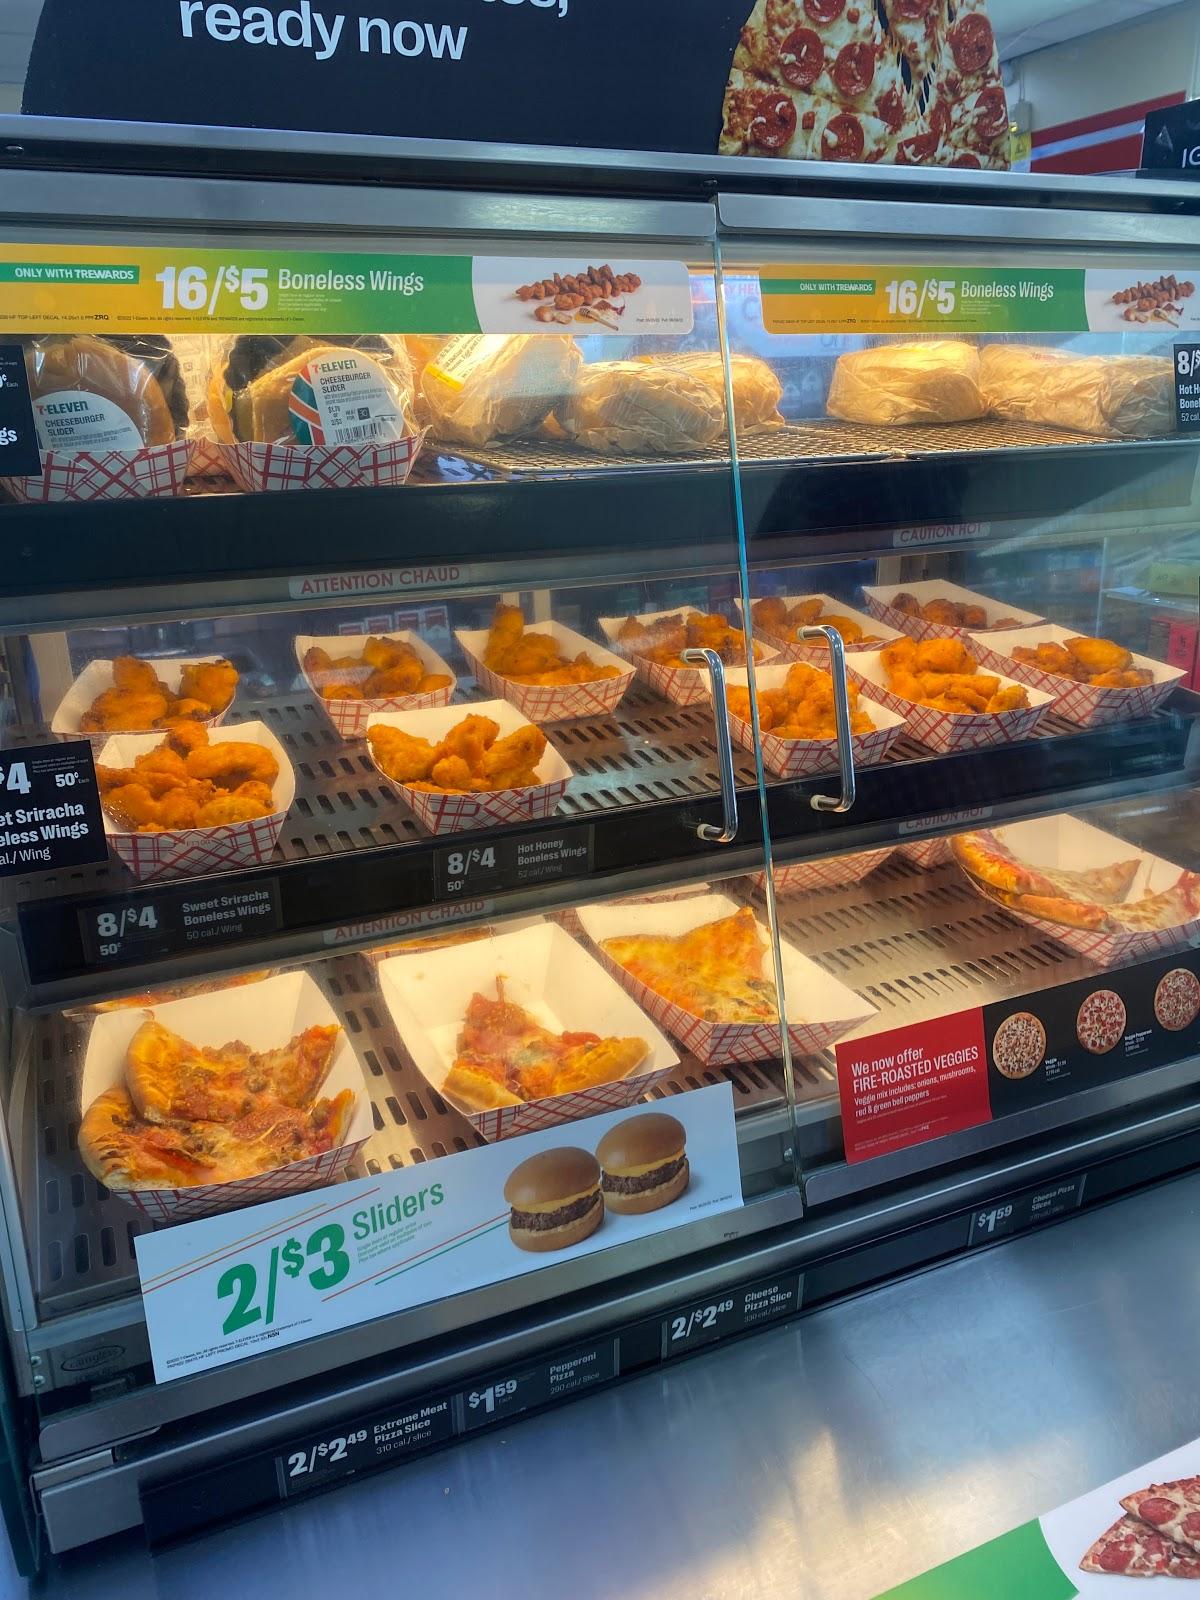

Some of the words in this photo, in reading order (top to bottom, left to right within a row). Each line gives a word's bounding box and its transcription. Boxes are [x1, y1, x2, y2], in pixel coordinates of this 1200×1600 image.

[180, 0, 341, 60] ready
[359, 15, 468, 60] now
[15, 267, 43, 278] ONLY
[45, 268, 73, 279] WITH
[74, 269, 134, 280] 7REWARDS
[278, 268, 366, 290] Boneless
[369, 270, 424, 296] Wings
[155, 265, 268, 315] 16/$5
[800, 283, 817, 291] ONLY
[818, 283, 836, 292] WITH
[836, 283, 873, 292] 7REWARDS
[961, 281, 1017, 298] Boneless
[1019, 281, 1054, 302] Wings
[885, 279, 956, 319] 16/$5
[320, 372, 372, 386] CHEESEBURGER
[321, 384, 346, 394] SLIDER
[1179, 384, 1193, 394] Hot
[35, 400, 89, 416] 7-ELEVEN
[1181, 412, 1189, 421] 52
[45, 413, 106, 428] CHEESEBURGER
[47, 426, 75, 437] SLIDER
[900, 524, 955, 543] CAUTION
[957, 522, 985, 537] HOT
[301, 572, 393, 594] ATTENTION
[400, 566, 460, 585] CHAUD
[15, 803, 85, 823] Sriracha
[40, 822, 89, 840] Wings
[19, 846, 51, 861] Wing
[518, 843, 534, 854] Hot
[536, 840, 564, 851] Honey
[518, 851, 559, 866] Boneless
[560, 846, 587, 858] Wings
[447, 847, 496, 875] 8/$4
[182, 901, 219, 913] Sweet
[221, 890, 269, 907] Sriracha
[97, 905, 158, 937] 8/$4
[184, 909, 236, 926] Boneless
[237, 902, 271, 917] Wings
[334, 912, 422, 941] ATTENTION
[427, 900, 485, 920] CHAUD
[187, 932, 199, 940] 50
[221, 923, 243, 933] Wing
[851, 1061, 869, 1077] We
[871, 1056, 895, 1072] now
[896, 1047, 924, 1064] offer
[853, 1059, 932, 1094] FIRE-ROASTED
[933, 1046, 979, 1070] VEGGIES
[854, 1093, 875, 1106] Veggie
[877, 1090, 887, 1100] mix
[888, 1082, 916, 1097] includes:
[917, 1077, 939, 1089] onions,
[940, 1065, 976, 1081] mushrooms,
[855, 1105, 866, 1117] red
[868, 1104, 872, 1113] &
[873, 1101, 891, 1113] green
[893, 1095, 904, 1106] bell
[904, 1090, 930, 1104] peppers
[1033, 1191, 1057, 1204] Cheese
[1058, 1185, 1075, 1195] Pizza
[352, 1182, 445, 1242] Sliders
[216, 1222, 351, 1336] 2/$3
[744, 1286, 778, 1302] Cheese
[744, 1300, 768, 1312] Pizza
[770, 1291, 792, 1305] Slice
[550, 1352, 596, 1375] Pepperoni
[550, 1370, 574, 1383] Pizza
[550, 1385, 564, 1395] 290
[373, 1412, 419, 1434] Extreme
[420, 1401, 448, 1418] Meat
[374, 1429, 402, 1444] Pizza
[405, 1419, 431, 1434] Slice
[376, 1444, 392, 1455] 310
[412, 1430, 432, 1442] slice
